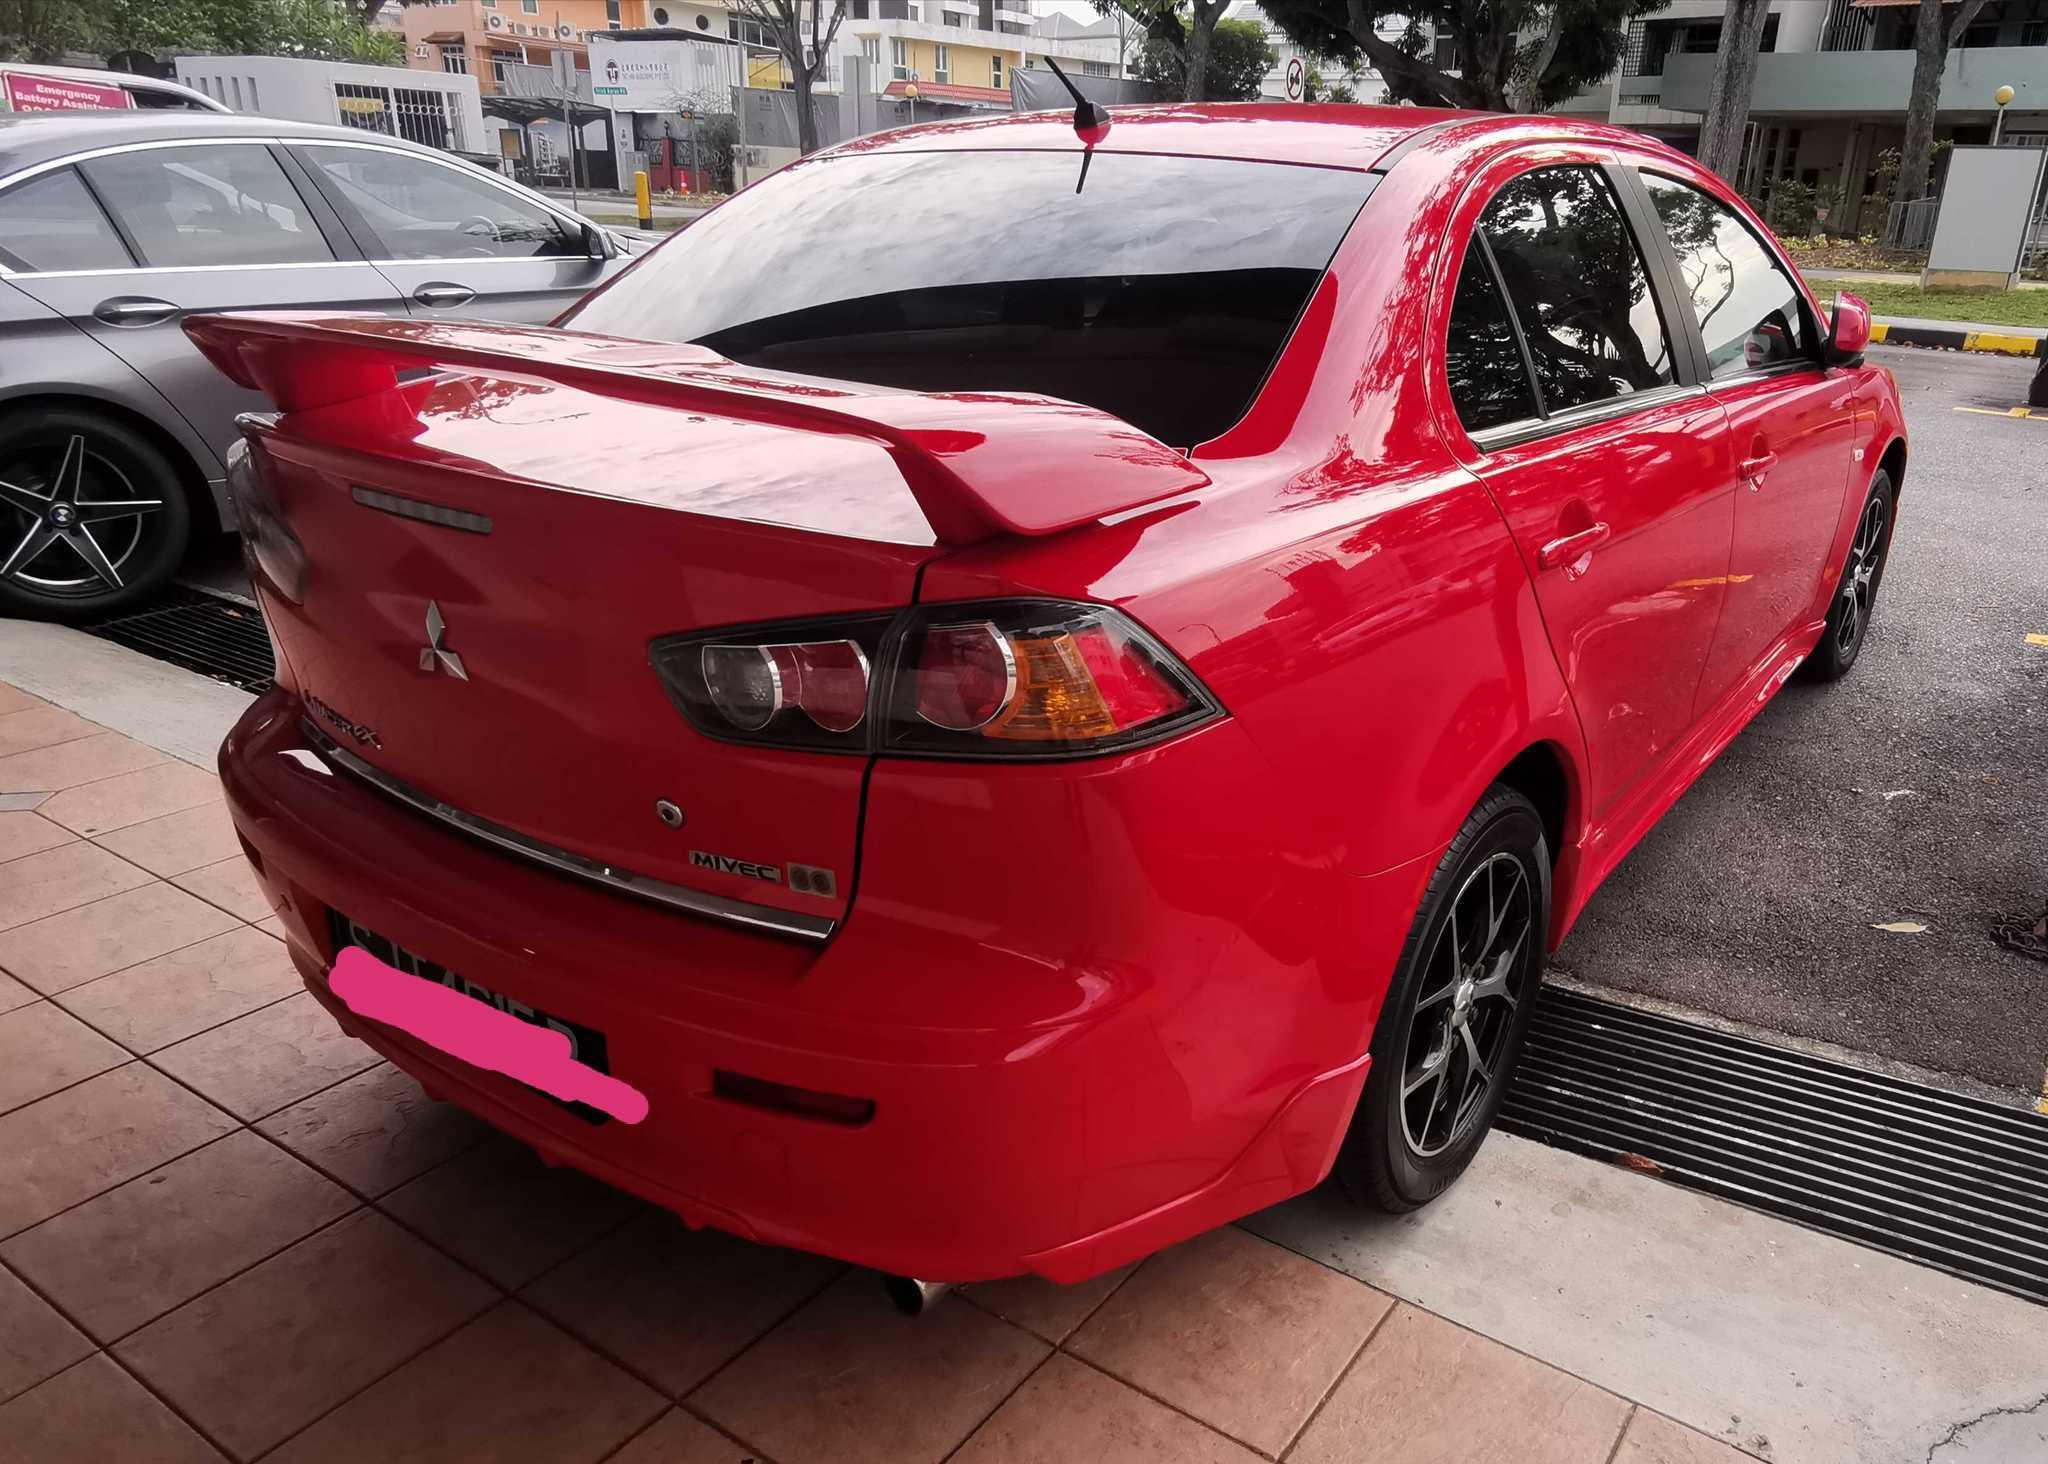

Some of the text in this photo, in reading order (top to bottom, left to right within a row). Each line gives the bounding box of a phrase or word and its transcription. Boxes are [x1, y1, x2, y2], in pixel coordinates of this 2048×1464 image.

[15, 91, 60, 107] Battery
[36, 84, 101, 103] Emergency
[694, 852, 776, 881] MIVEC
